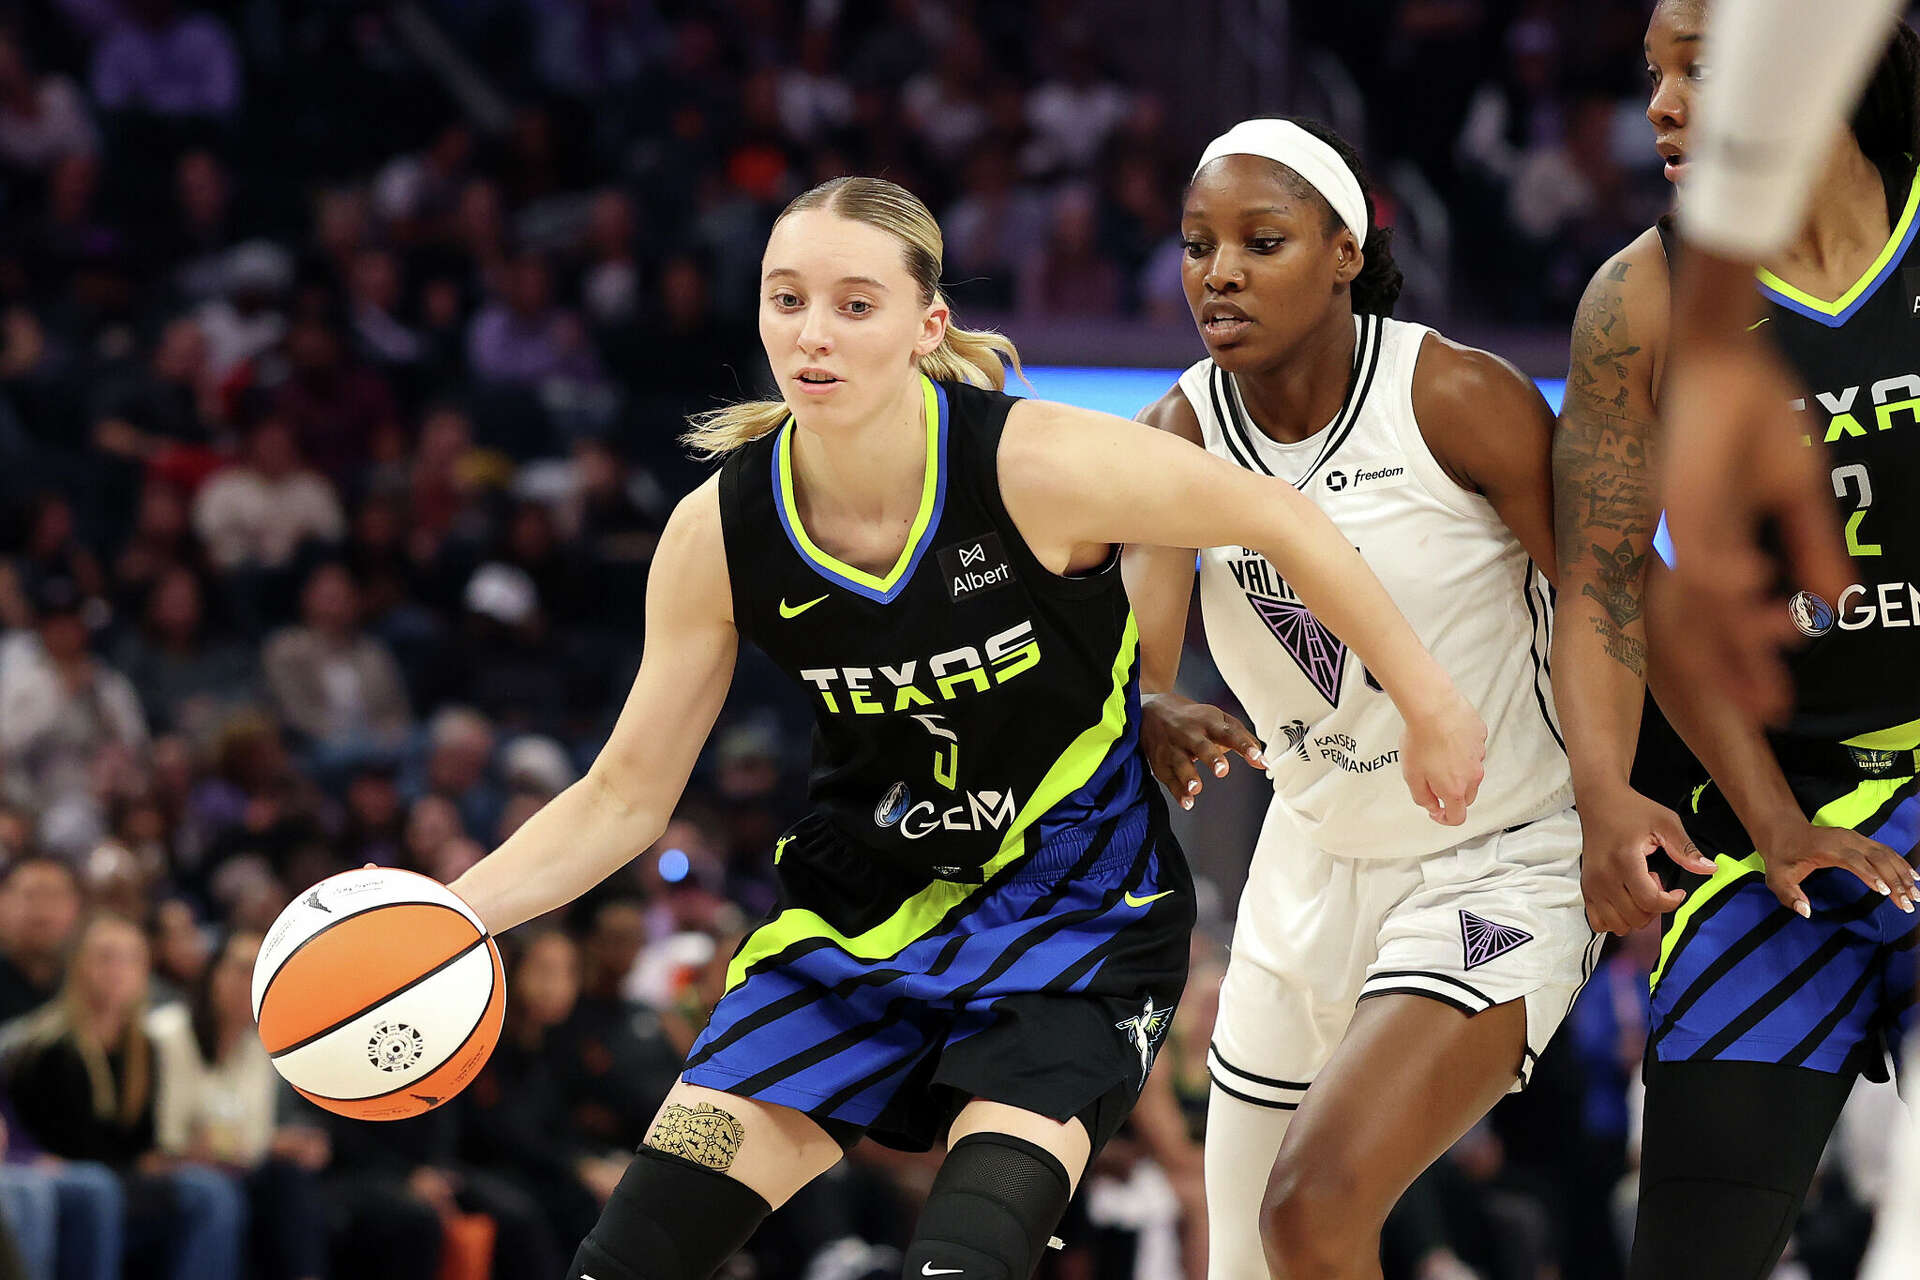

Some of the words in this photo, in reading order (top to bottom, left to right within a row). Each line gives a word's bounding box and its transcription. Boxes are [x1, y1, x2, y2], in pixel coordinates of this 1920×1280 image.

[1353, 466, 1404, 487] freedom
[1831, 463, 1882, 557] 2
[953, 563, 1009, 597] Albert
[800, 620, 1042, 714] TEXAS
[910, 714, 958, 791] 5
[1314, 734, 1357, 754] KAISER
